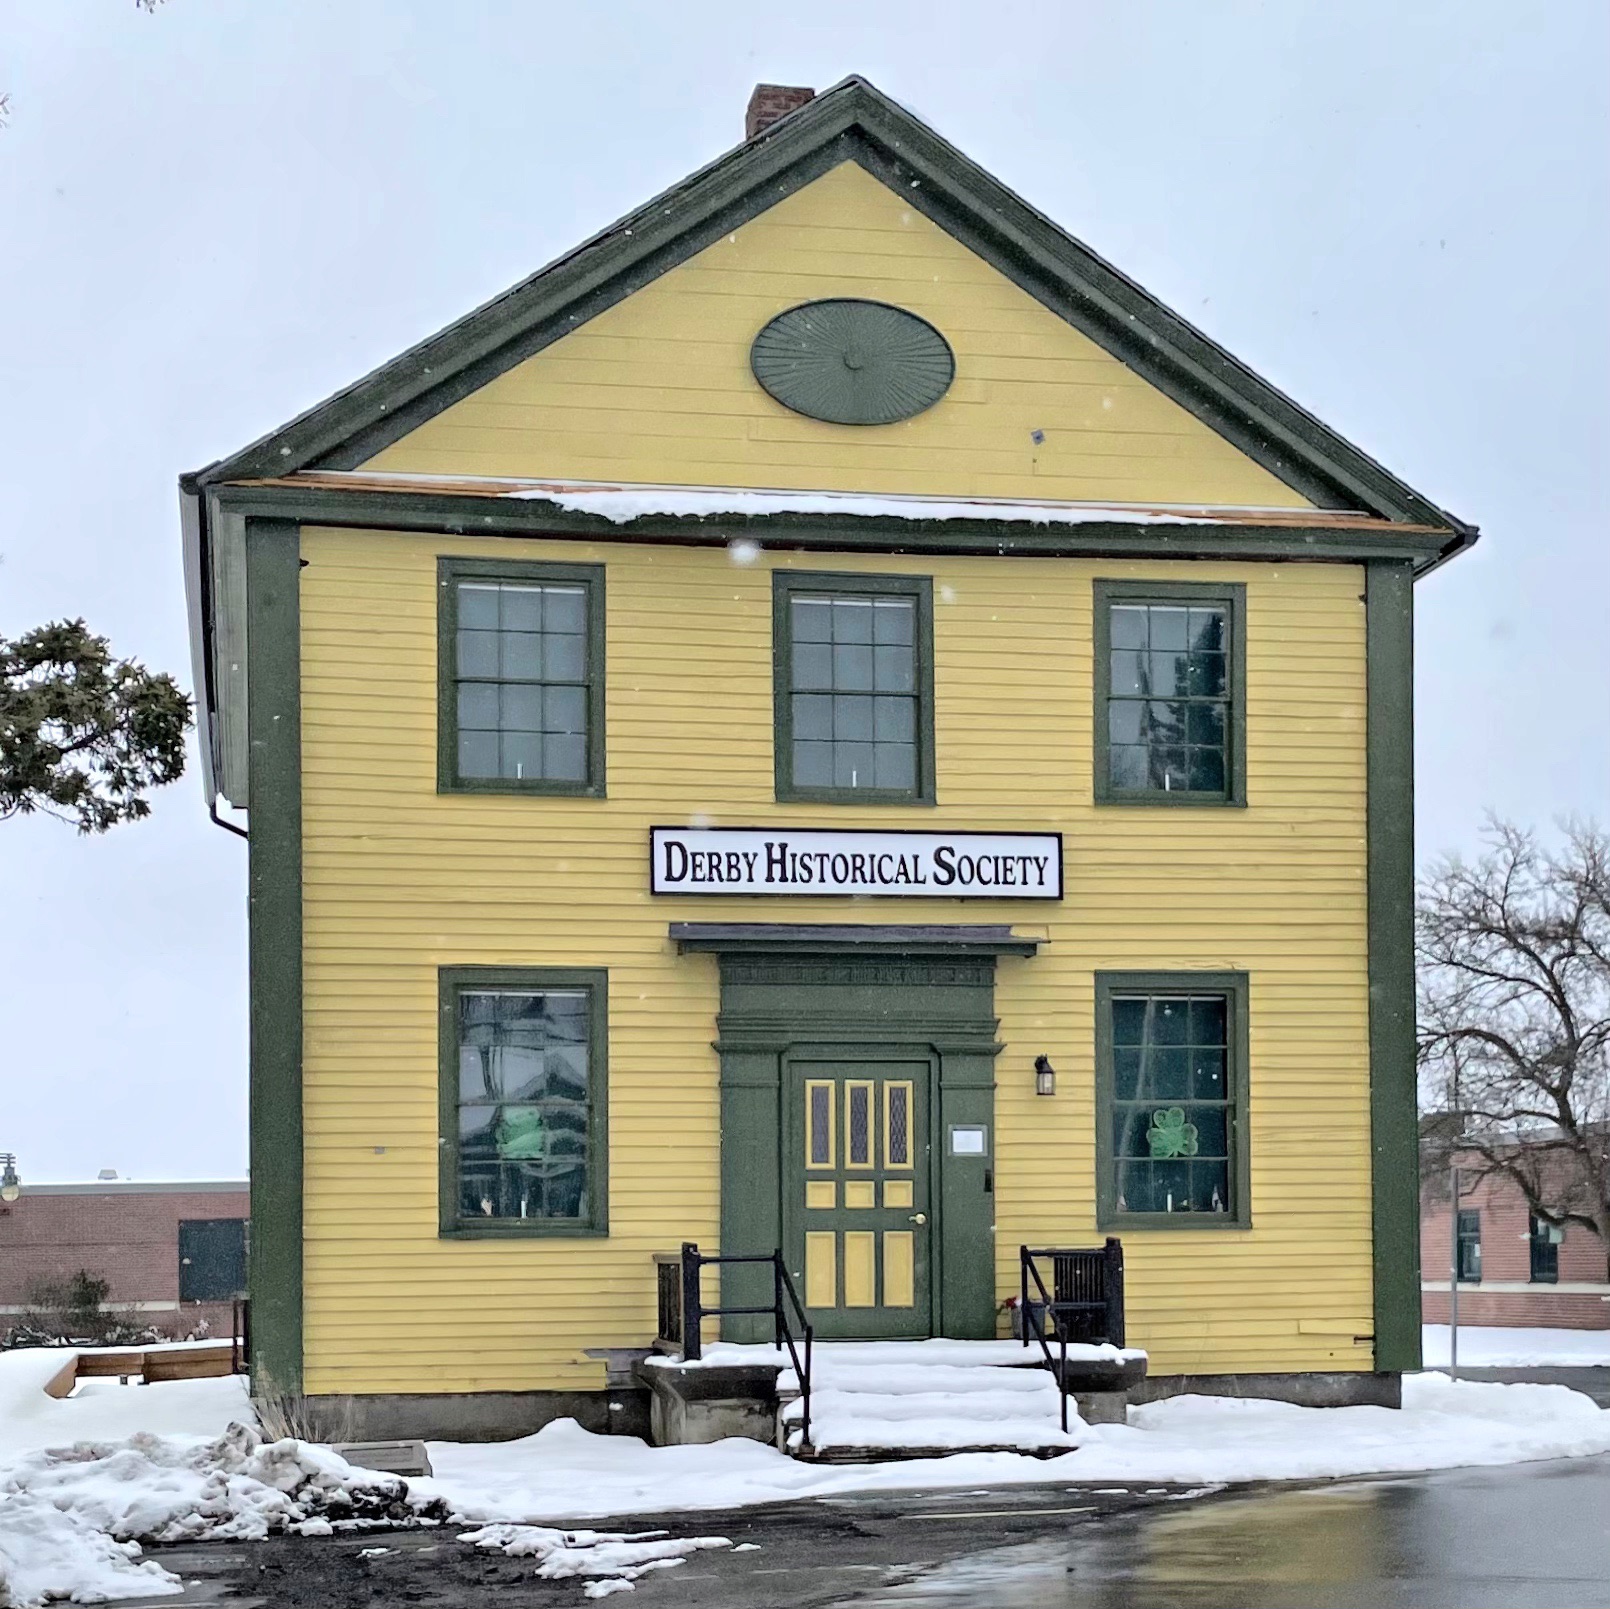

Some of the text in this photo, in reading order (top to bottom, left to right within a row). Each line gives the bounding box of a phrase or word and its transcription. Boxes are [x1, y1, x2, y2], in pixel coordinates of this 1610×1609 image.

[663, 841, 1049, 886] DERBY HISTORICAL SOCIETY
